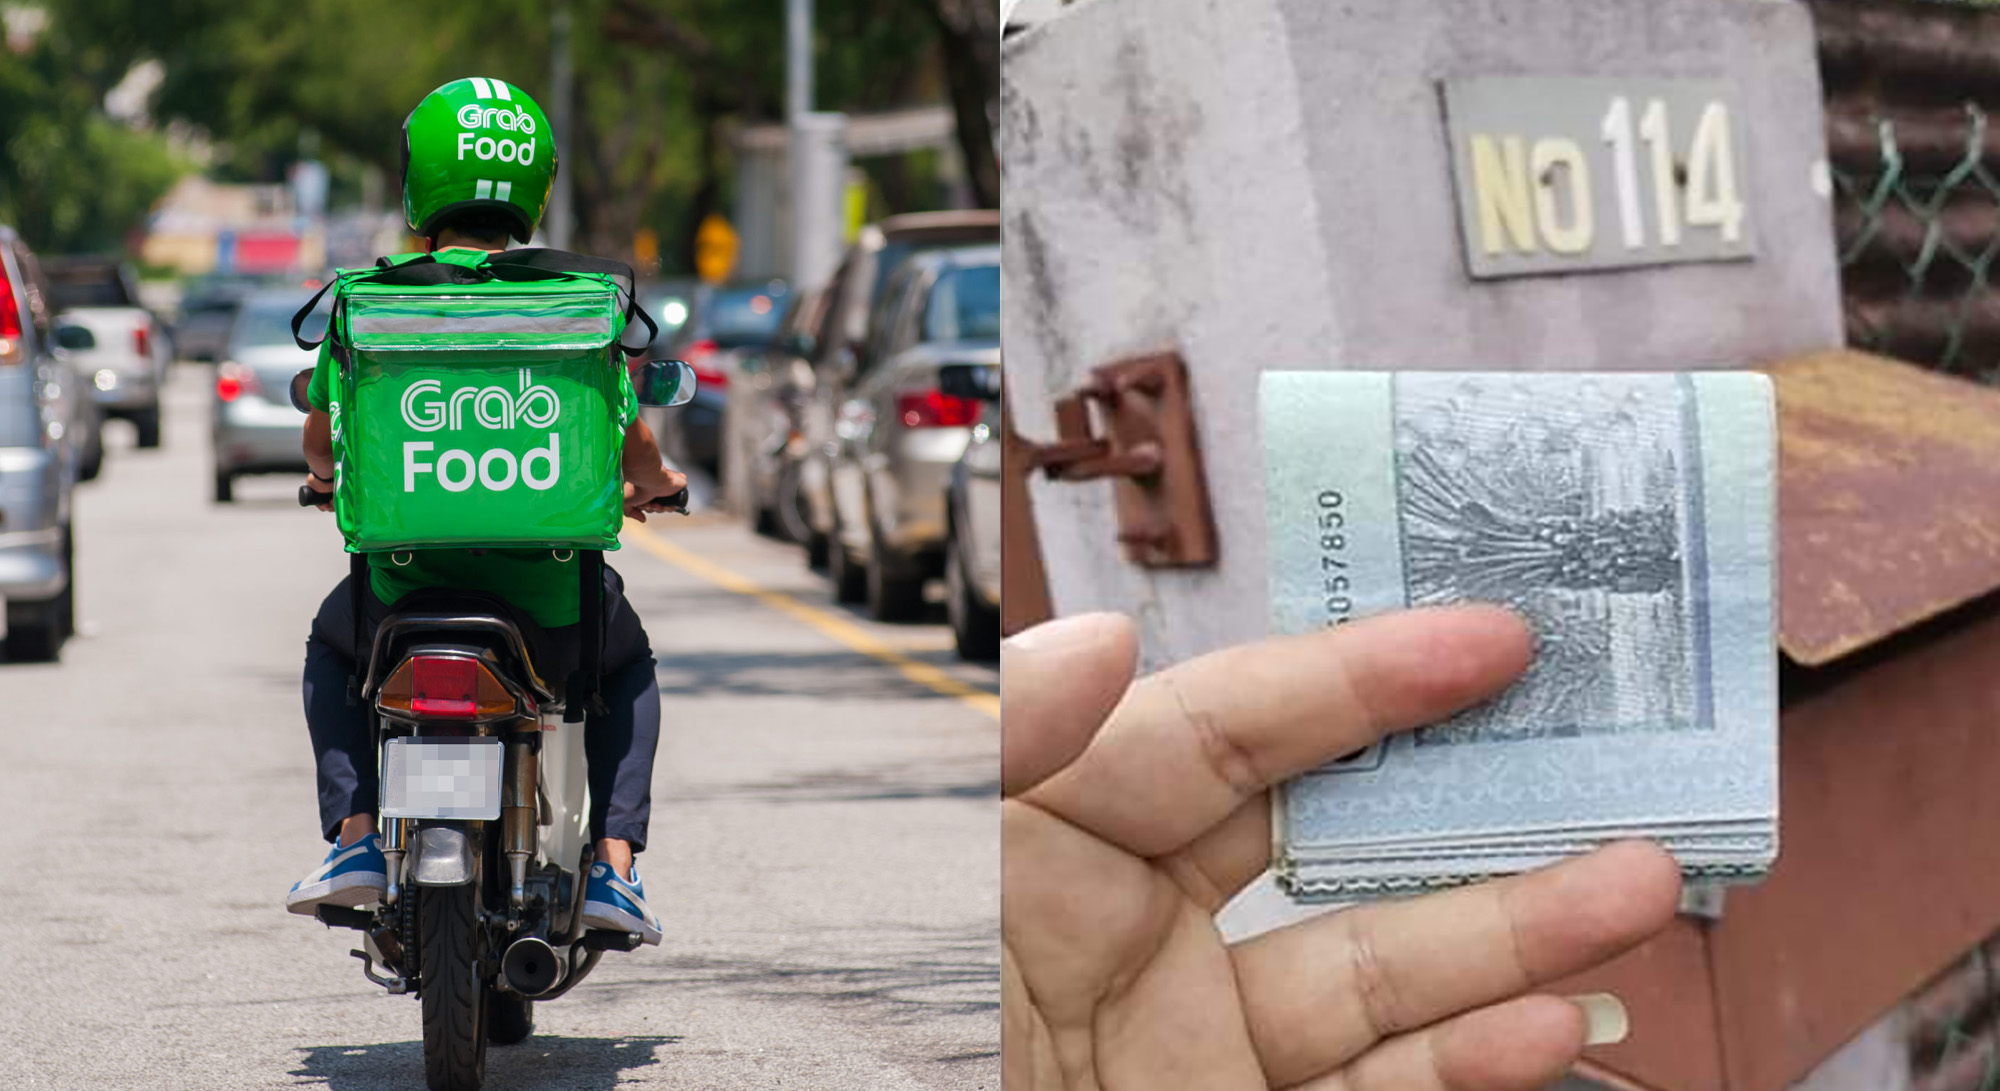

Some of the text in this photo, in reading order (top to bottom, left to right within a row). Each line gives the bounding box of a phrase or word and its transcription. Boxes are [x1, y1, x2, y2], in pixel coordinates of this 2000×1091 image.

[457, 104, 536, 135] Grab
[457, 132, 536, 166] Food
[1469, 96, 1745, 255] NO 114
[400, 368, 561, 432] Grab
[403, 432, 560, 493] Food
